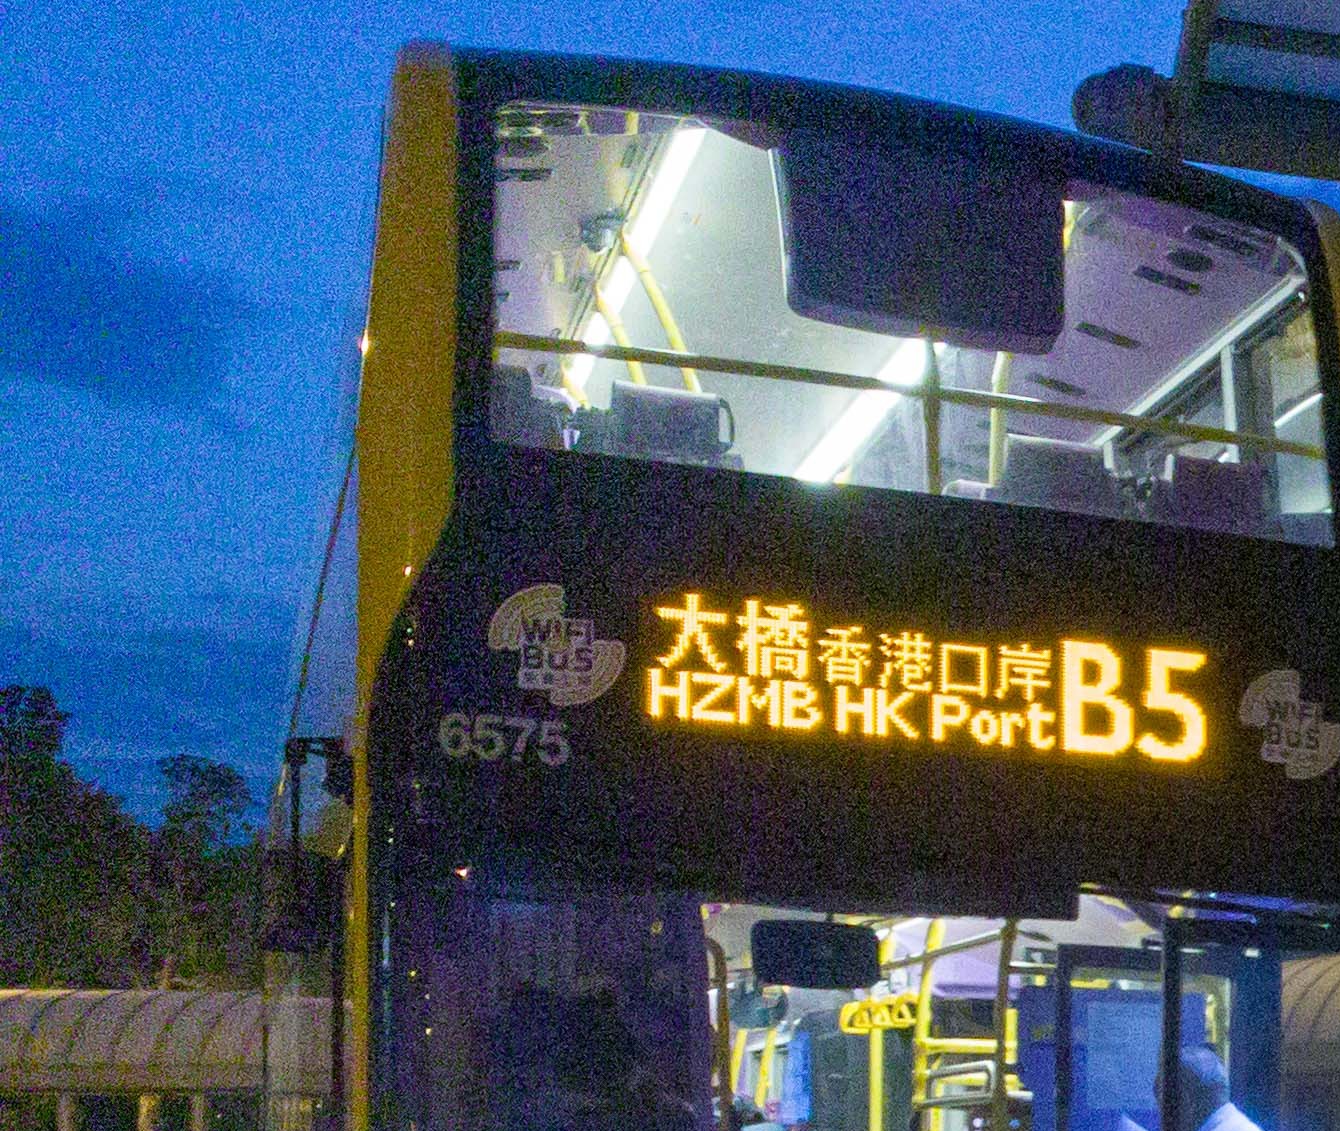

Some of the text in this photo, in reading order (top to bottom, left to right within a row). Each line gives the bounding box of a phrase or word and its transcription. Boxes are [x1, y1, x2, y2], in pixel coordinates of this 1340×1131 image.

[522, 645, 594, 672] BUS
[655, 593, 1052, 701] 大橋香港口岸
[438, 712, 571, 767] 6575
[647, 667, 1057, 751] HZMB HK Port
[1061, 637, 1208, 763] B5
